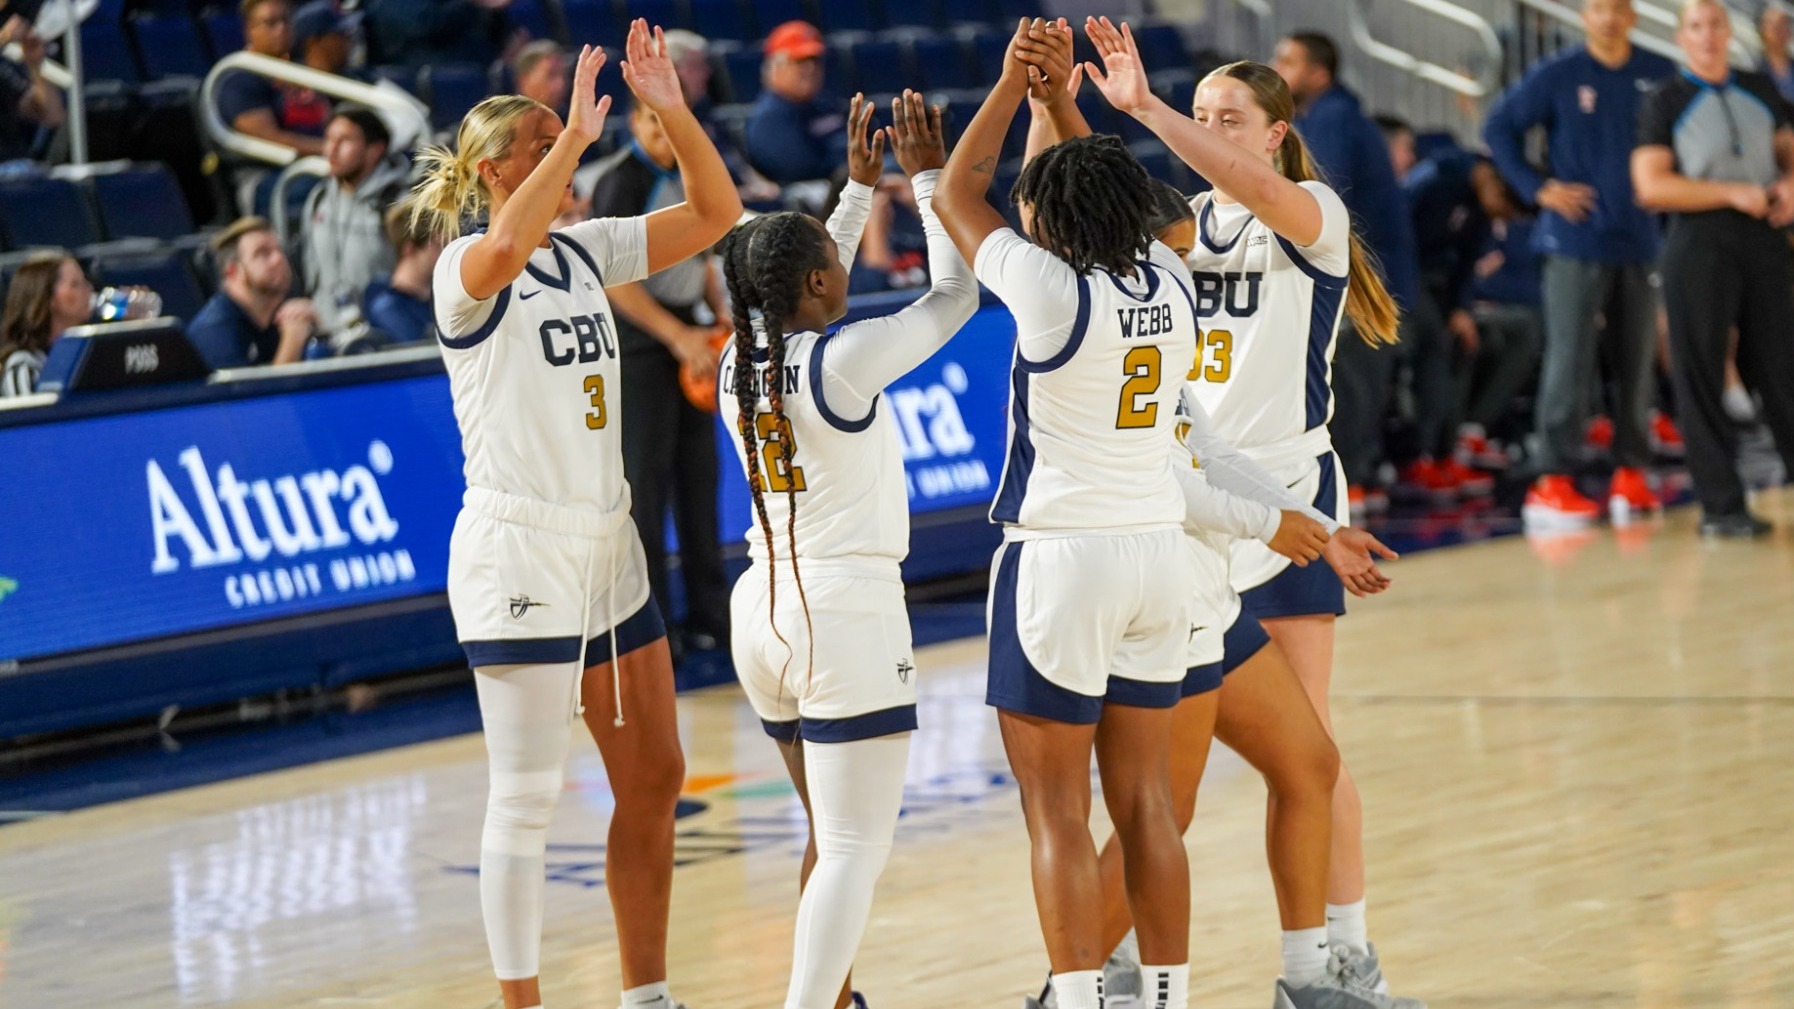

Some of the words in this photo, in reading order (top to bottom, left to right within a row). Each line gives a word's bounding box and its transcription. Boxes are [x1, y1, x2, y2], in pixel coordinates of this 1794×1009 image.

[1117, 303, 1173, 338] WEBB
[1193, 271, 1262, 317] BU
[539, 312, 616, 367] CBU
[583, 373, 608, 430] 3
[1115, 345, 1162, 430] 2
[225, 563, 323, 609] CREDIT
[329, 548, 416, 591] UNION
